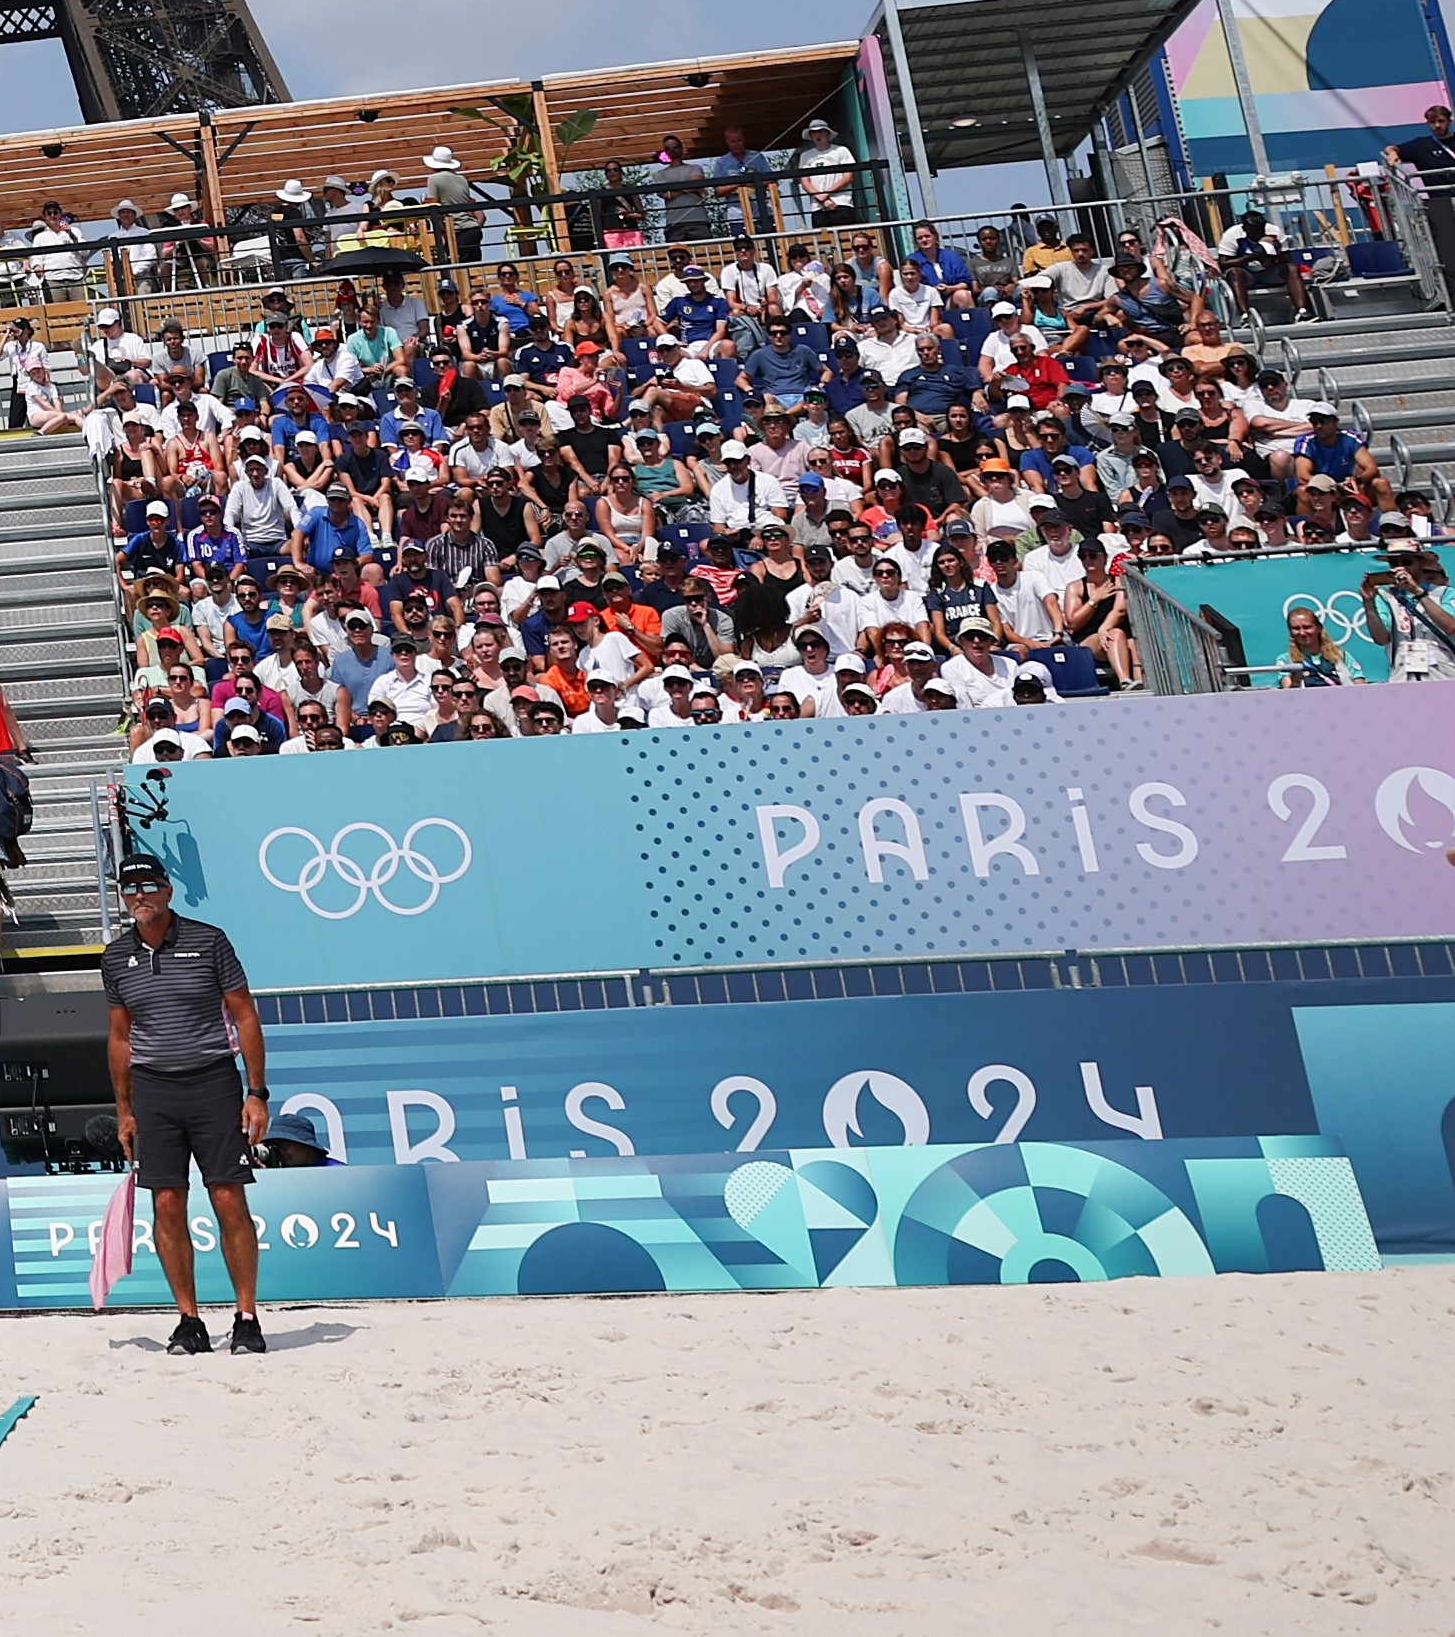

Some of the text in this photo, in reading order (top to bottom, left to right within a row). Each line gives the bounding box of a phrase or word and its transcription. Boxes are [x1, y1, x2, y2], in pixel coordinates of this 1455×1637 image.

[200, 543, 213, 558] 10
[945, 603, 981, 622] FRANCE
[709, 1061, 1165, 1153] 2024
[49, 1212, 400, 1257] PRS 2024
